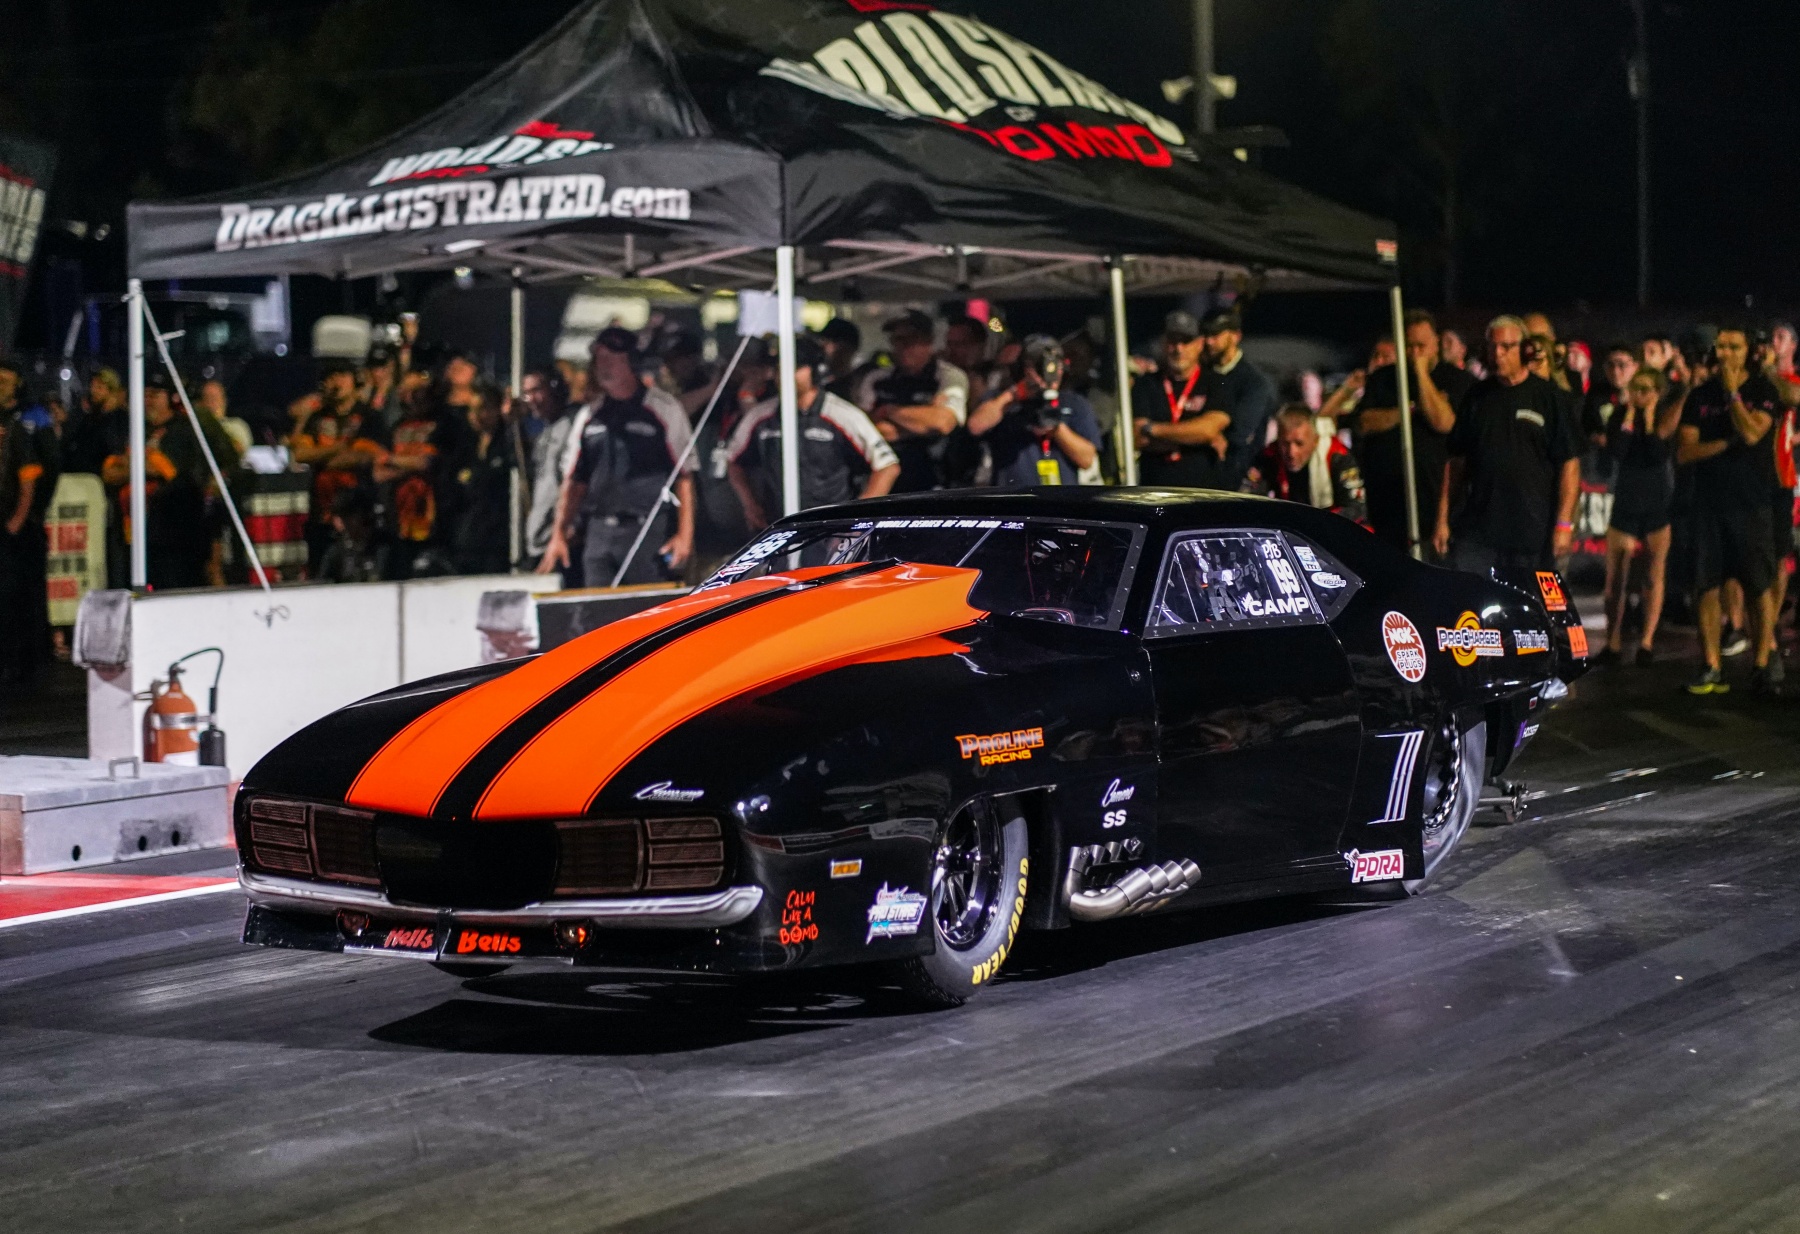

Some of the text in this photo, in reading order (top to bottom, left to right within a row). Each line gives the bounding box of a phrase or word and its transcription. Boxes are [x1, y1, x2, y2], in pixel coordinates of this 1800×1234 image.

[875, 520, 911, 528] WORLD
[908, 520, 944, 528] SERIES
[941, 519, 958, 528] OF
[955, 520, 979, 528] PRO
[733, 539, 788, 566] 199
[1266, 558, 1300, 594] 199
[1248, 597, 1310, 616] CAMP
[1387, 626, 1415, 645] NGK
[1396, 650, 1419, 659] SPARK
[1400, 660, 1422, 669] PLUGS
[980, 749, 1032, 766] RACING
[1102, 778, 1135, 807] Camaro
[1102, 809, 1127, 829] SS
[1354, 852, 1402, 880] PDRA
[786, 889, 816, 908] CALM
[804, 906, 812, 921] A
[384, 926, 522, 954] Hells Bells
[779, 923, 819, 944] BOMB
